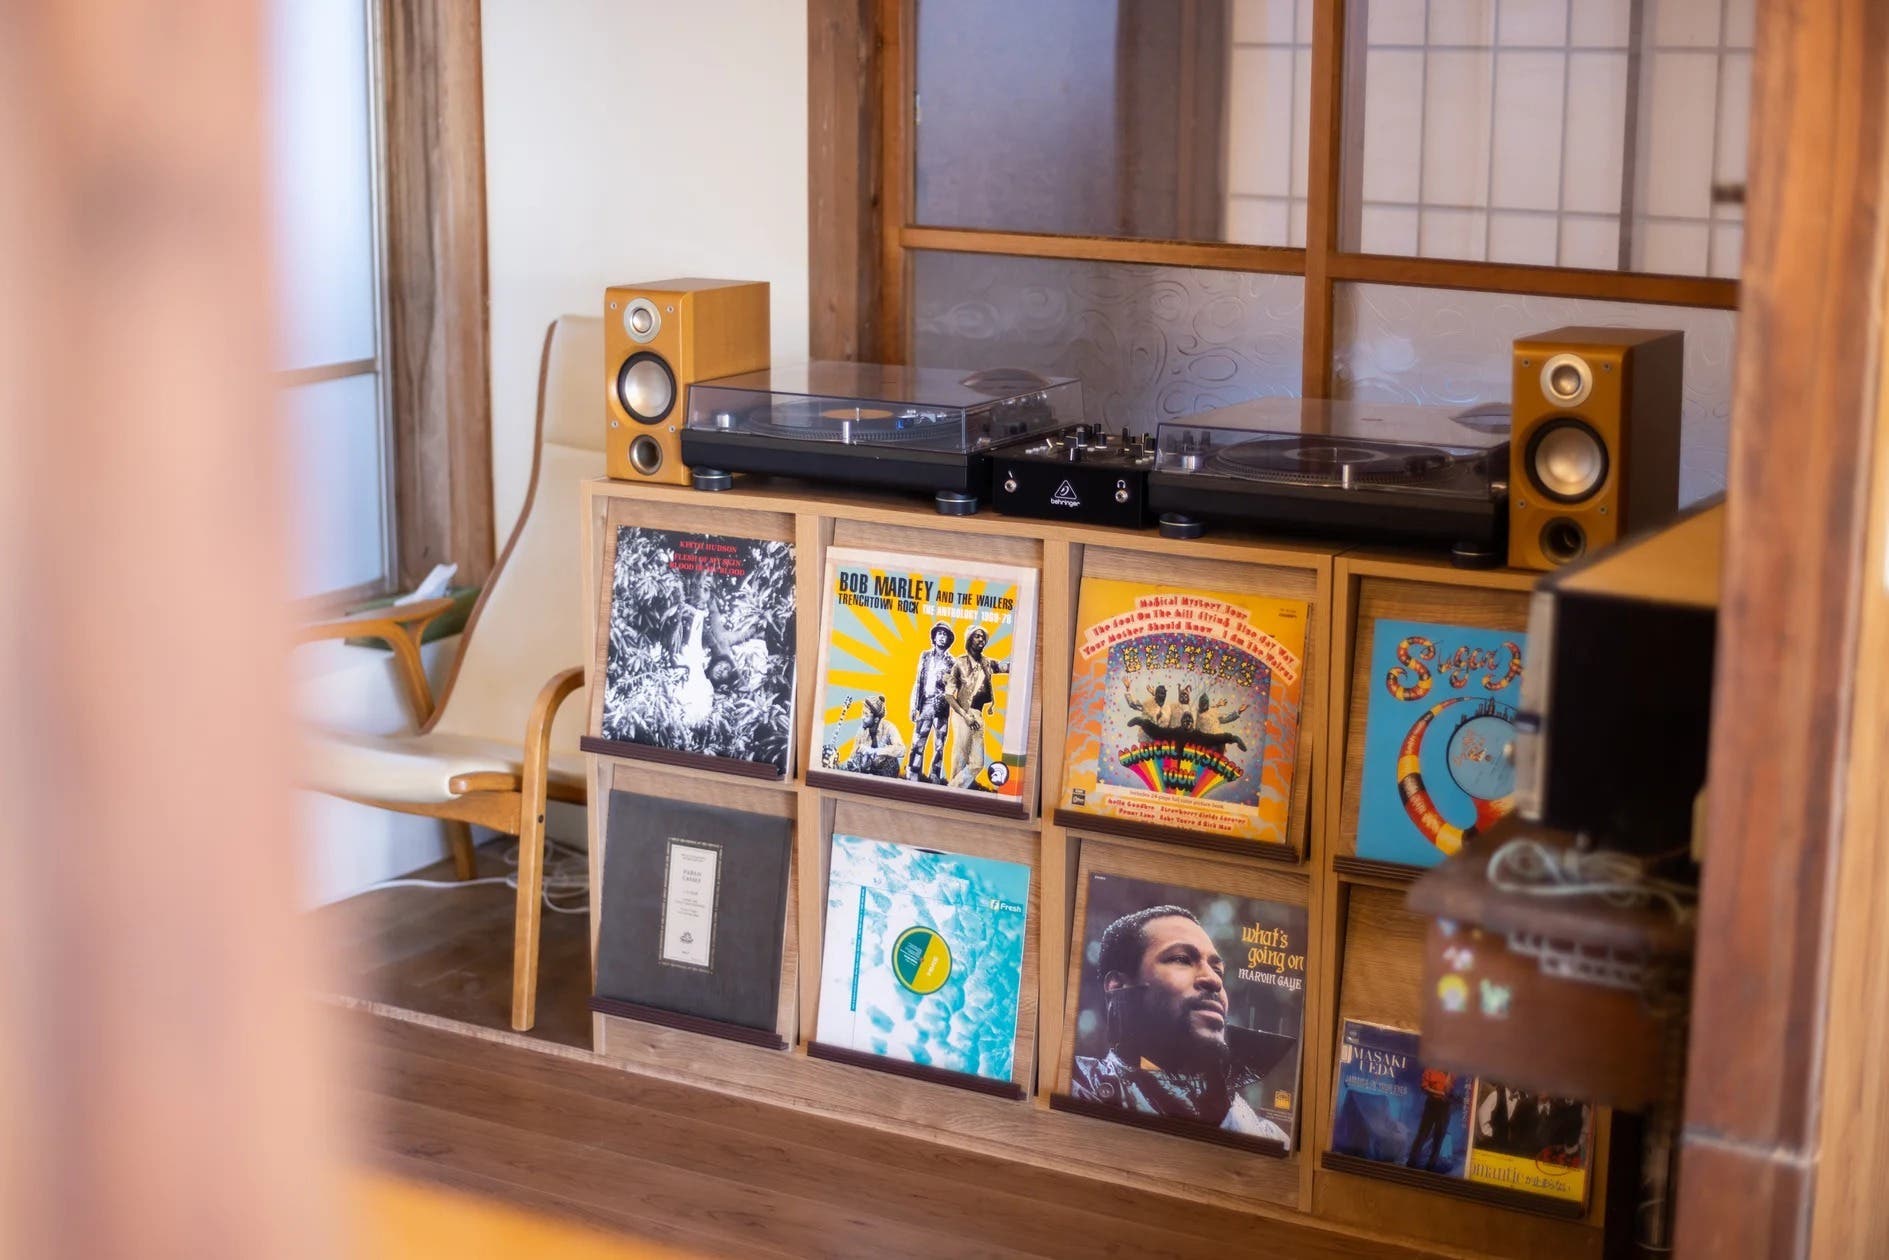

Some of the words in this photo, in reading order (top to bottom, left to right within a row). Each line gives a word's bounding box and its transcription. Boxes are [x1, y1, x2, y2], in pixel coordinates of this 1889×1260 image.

[1050, 498, 1080, 507] behringer
[674, 553, 697, 562] FLESH
[679, 541, 704, 549] KEITH
[706, 544, 737, 553] HUDSON
[669, 561, 694, 570] BLOOD
[719, 567, 745, 576] BLOOD
[839, 571, 868, 594] BOB
[874, 575, 934, 602] MARLEY
[935, 590, 954, 604] AND
[957, 592, 973, 605] THE
[976, 594, 1014, 611] WAILERS
[838, 593, 893, 610] TRENCHTOWN
[897, 600, 919, 614] ROCK
[1140, 596, 1178, 608] Magical
[1181, 597, 1221, 610] Mystery
[1225, 605, 1247, 620] Tour
[1083, 640, 1106, 655] Your
[1108, 626, 1144, 643] Mother
[1147, 621, 1181, 631] Should
[1185, 621, 1213, 633] Know
[1093, 624, 1110, 637] The
[1137, 612, 1151, 621] On
[1152, 609, 1171, 618] The
[1278, 647, 1295, 664] Way
[1123, 643, 1256, 687] BEATLES
[1386, 636, 1499, 701] Sugar
[1117, 740, 1179, 768] MAGICAL
[1182, 742, 1244, 782] MYSTERY
[1162, 767, 1196, 792] TOUR
[1108, 798, 1125, 806] Hello
[1127, 802, 1155, 810] Goodbye
[1160, 806, 1198, 817] Strawberry
[1000, 902, 1022, 913] Fresh
[1241, 922, 1288, 948] what's
[1247, 946, 1286, 973] going
[1287, 954, 1304, 971] on
[1238, 968, 1276, 985] MARVIN
[1277, 975, 1302, 991] GAYE
[1354, 1046, 1406, 1069] MASAKI
[1359, 1060, 1394, 1078] UEDA
[1471, 1162, 1521, 1185] omantic
